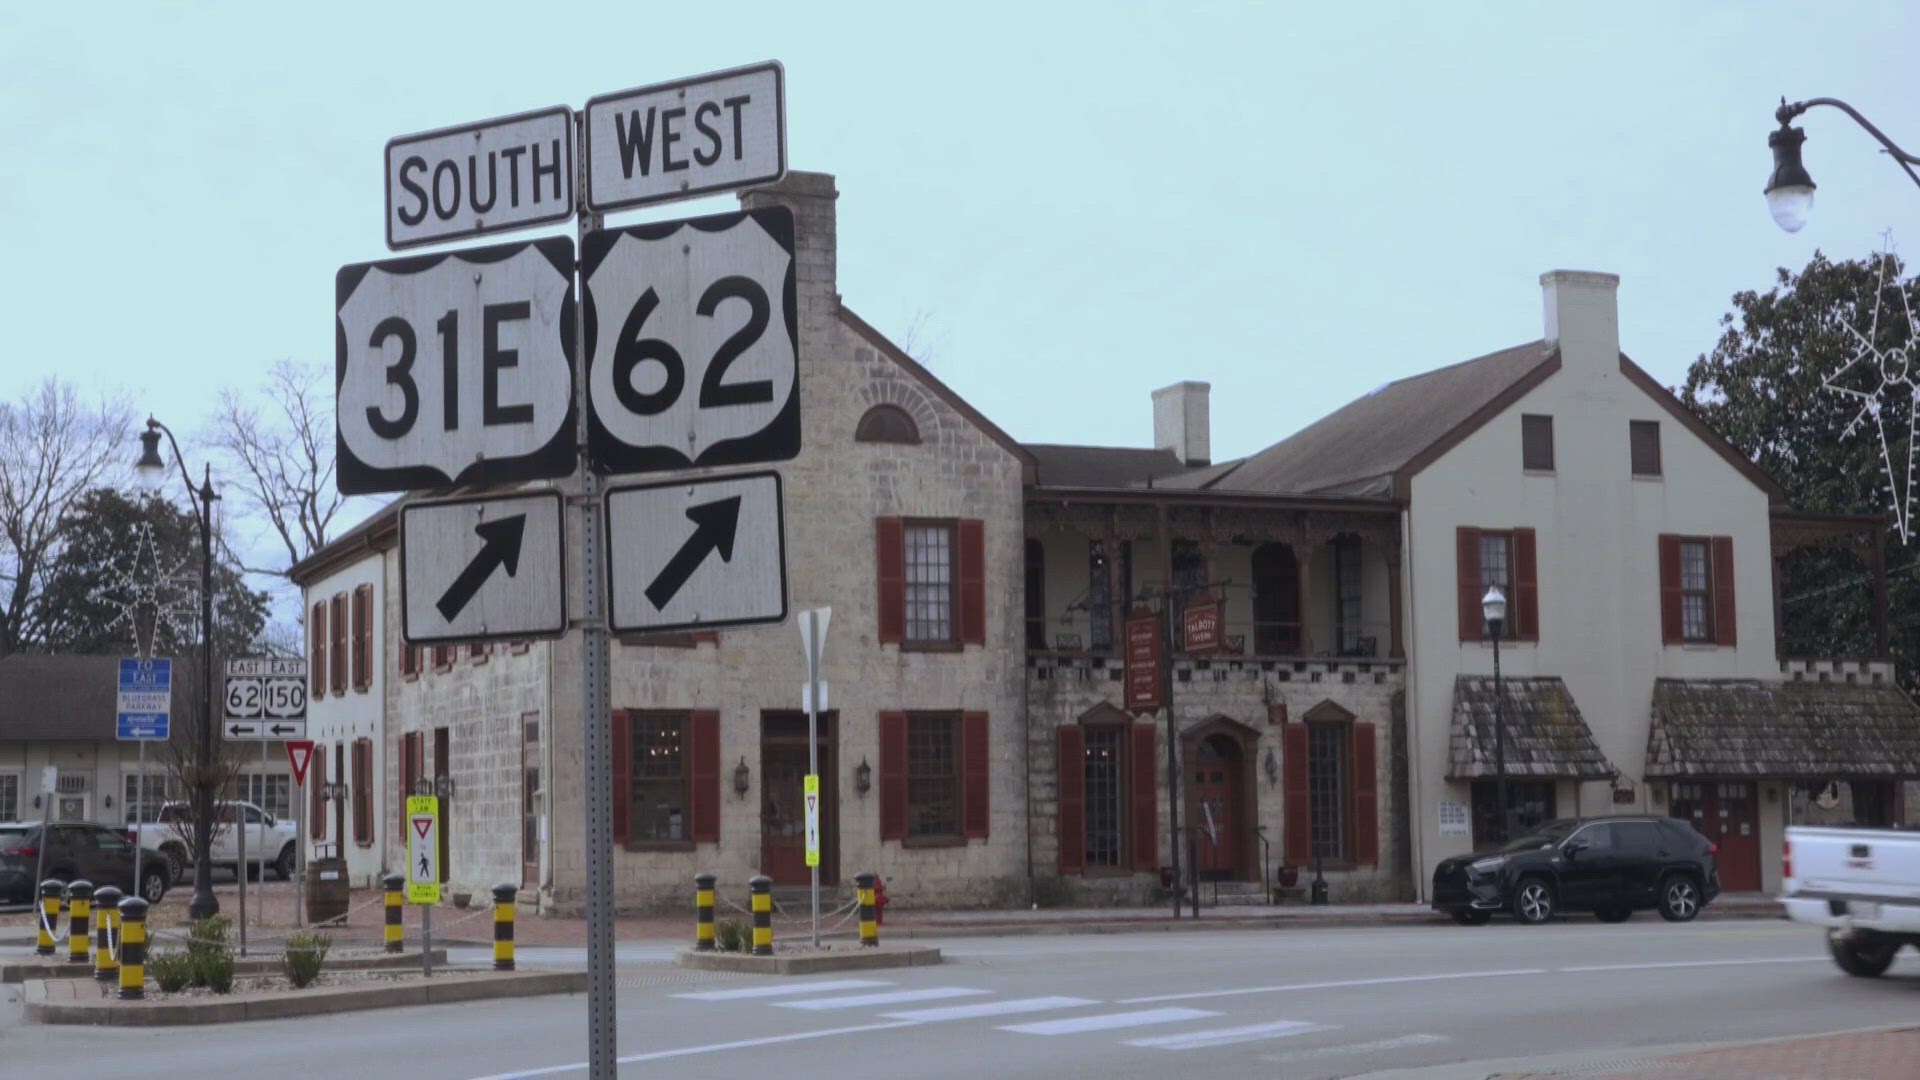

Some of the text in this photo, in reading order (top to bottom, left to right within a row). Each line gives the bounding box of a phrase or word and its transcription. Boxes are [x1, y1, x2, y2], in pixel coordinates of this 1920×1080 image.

[614, 94, 751, 180] WEST
[396, 138, 562, 226] SOUTH
[612, 274, 775, 417] 62
[365, 300, 535, 441] 31E
[1187, 619, 1216, 634] TALBOTT
[137, 660, 153, 671] TO
[230, 660, 260, 674] EAST
[271, 660, 301, 674] EAST
[132, 671, 157, 683] EAST
[122, 693, 167, 702] BLUEGRASS
[229, 685, 259, 708] 62
[268, 685, 303, 708] 150
[125, 702, 162, 711] PARKWAY
